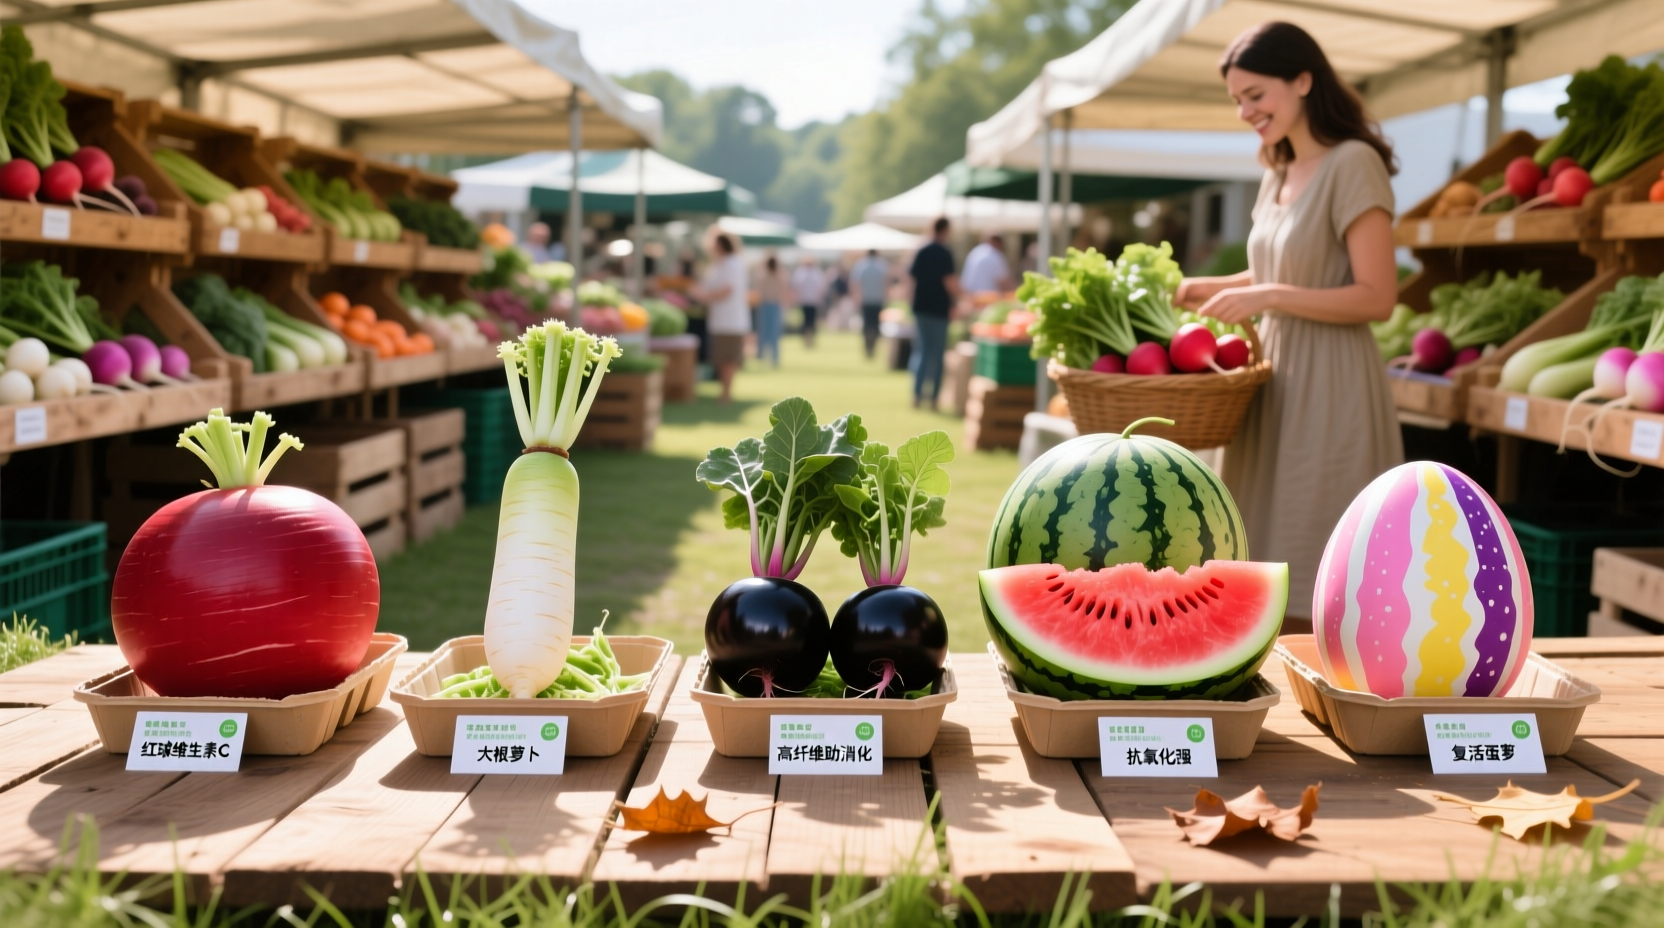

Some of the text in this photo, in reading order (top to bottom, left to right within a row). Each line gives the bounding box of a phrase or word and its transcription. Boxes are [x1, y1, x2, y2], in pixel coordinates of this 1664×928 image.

[477, 745, 540, 763] 大根萝卜
[777, 744, 872, 763] 高纤维助消化
